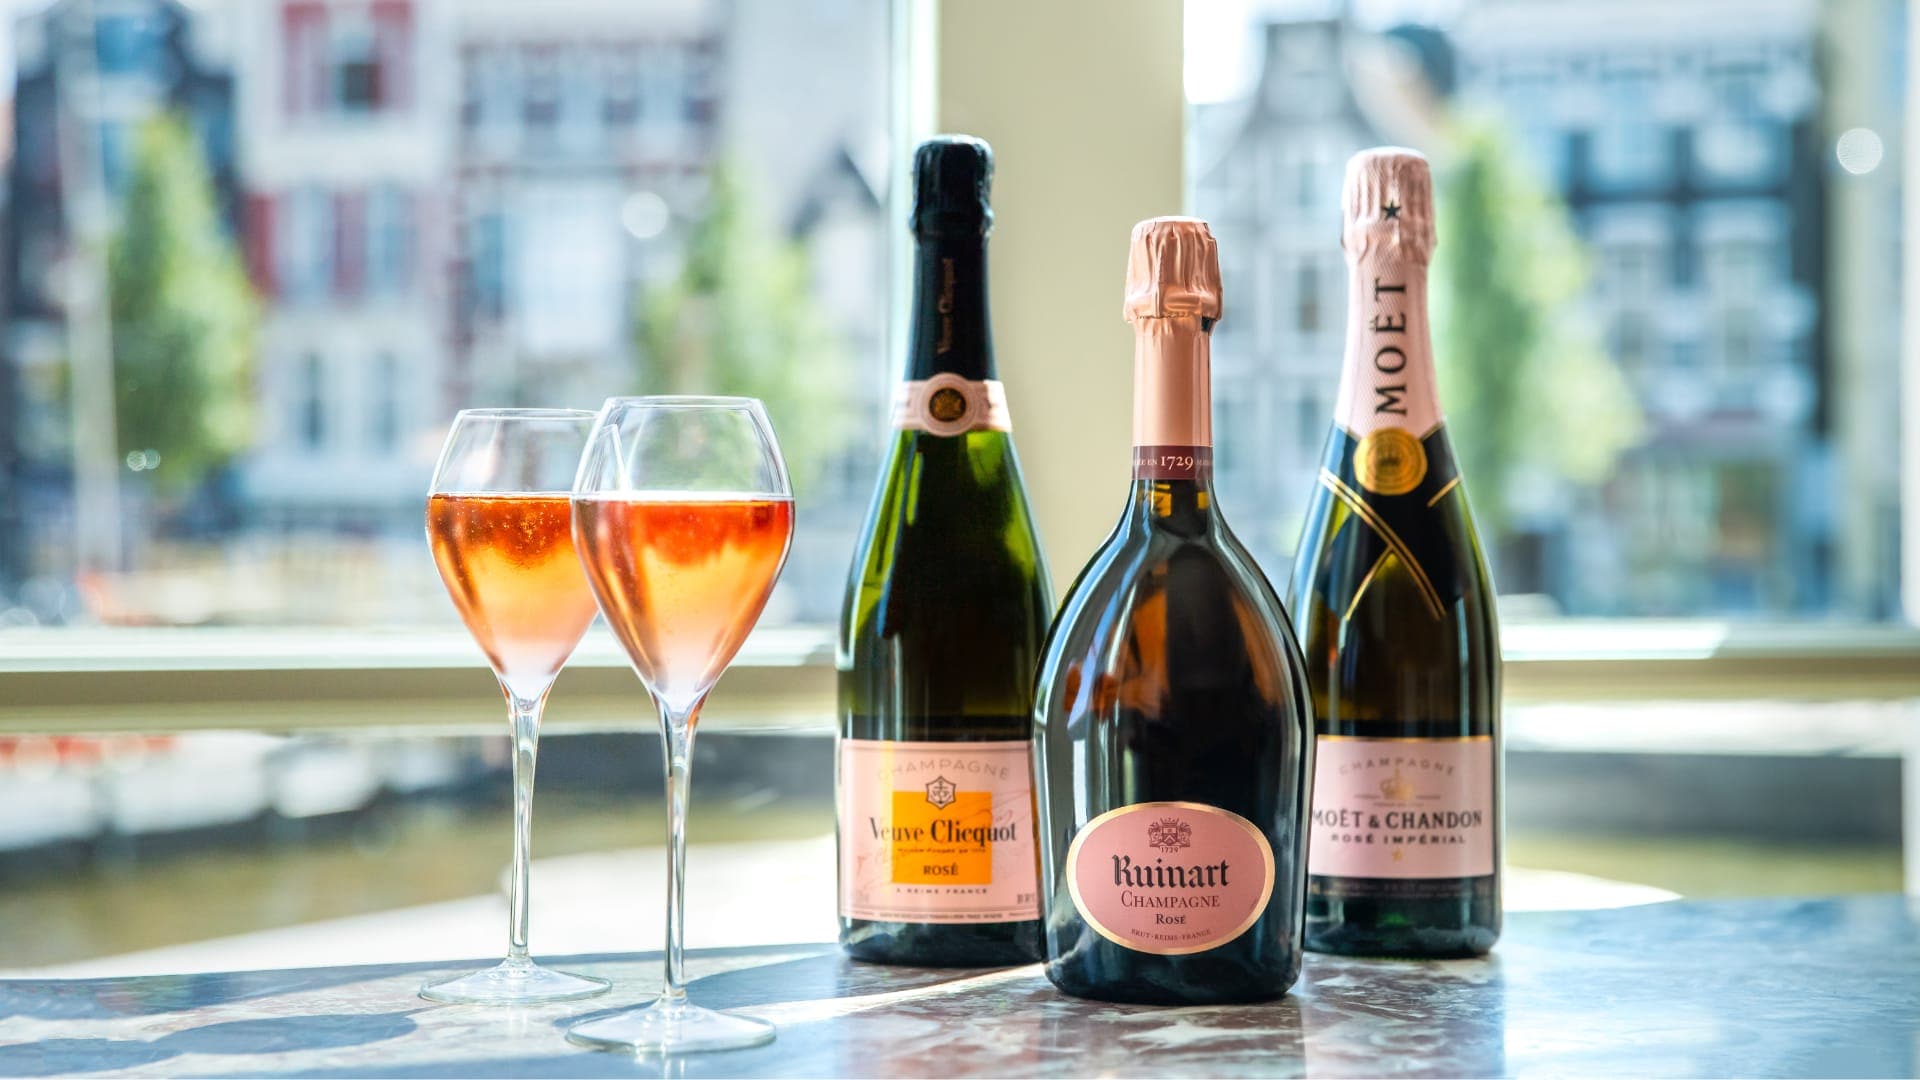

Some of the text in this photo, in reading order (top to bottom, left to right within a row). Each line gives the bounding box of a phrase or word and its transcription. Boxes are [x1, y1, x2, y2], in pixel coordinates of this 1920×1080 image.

[1369, 277, 1408, 417] MOËT
[1160, 455, 1194, 471] 1729
[878, 758, 1009, 780] CHAMPAGNE
[1339, 757, 1455, 776] CHAMPAGNE
[1368, 814, 1381, 829] &
[1385, 811, 1482, 830] CHANDON
[869, 817, 1017, 847] Veuve Clicquot
[1331, 833, 1466, 845] ROSÉ IMPÉRIAL
[922, 862, 959, 876] ROSÉ
[1112, 854, 1230, 888] Ruinart
